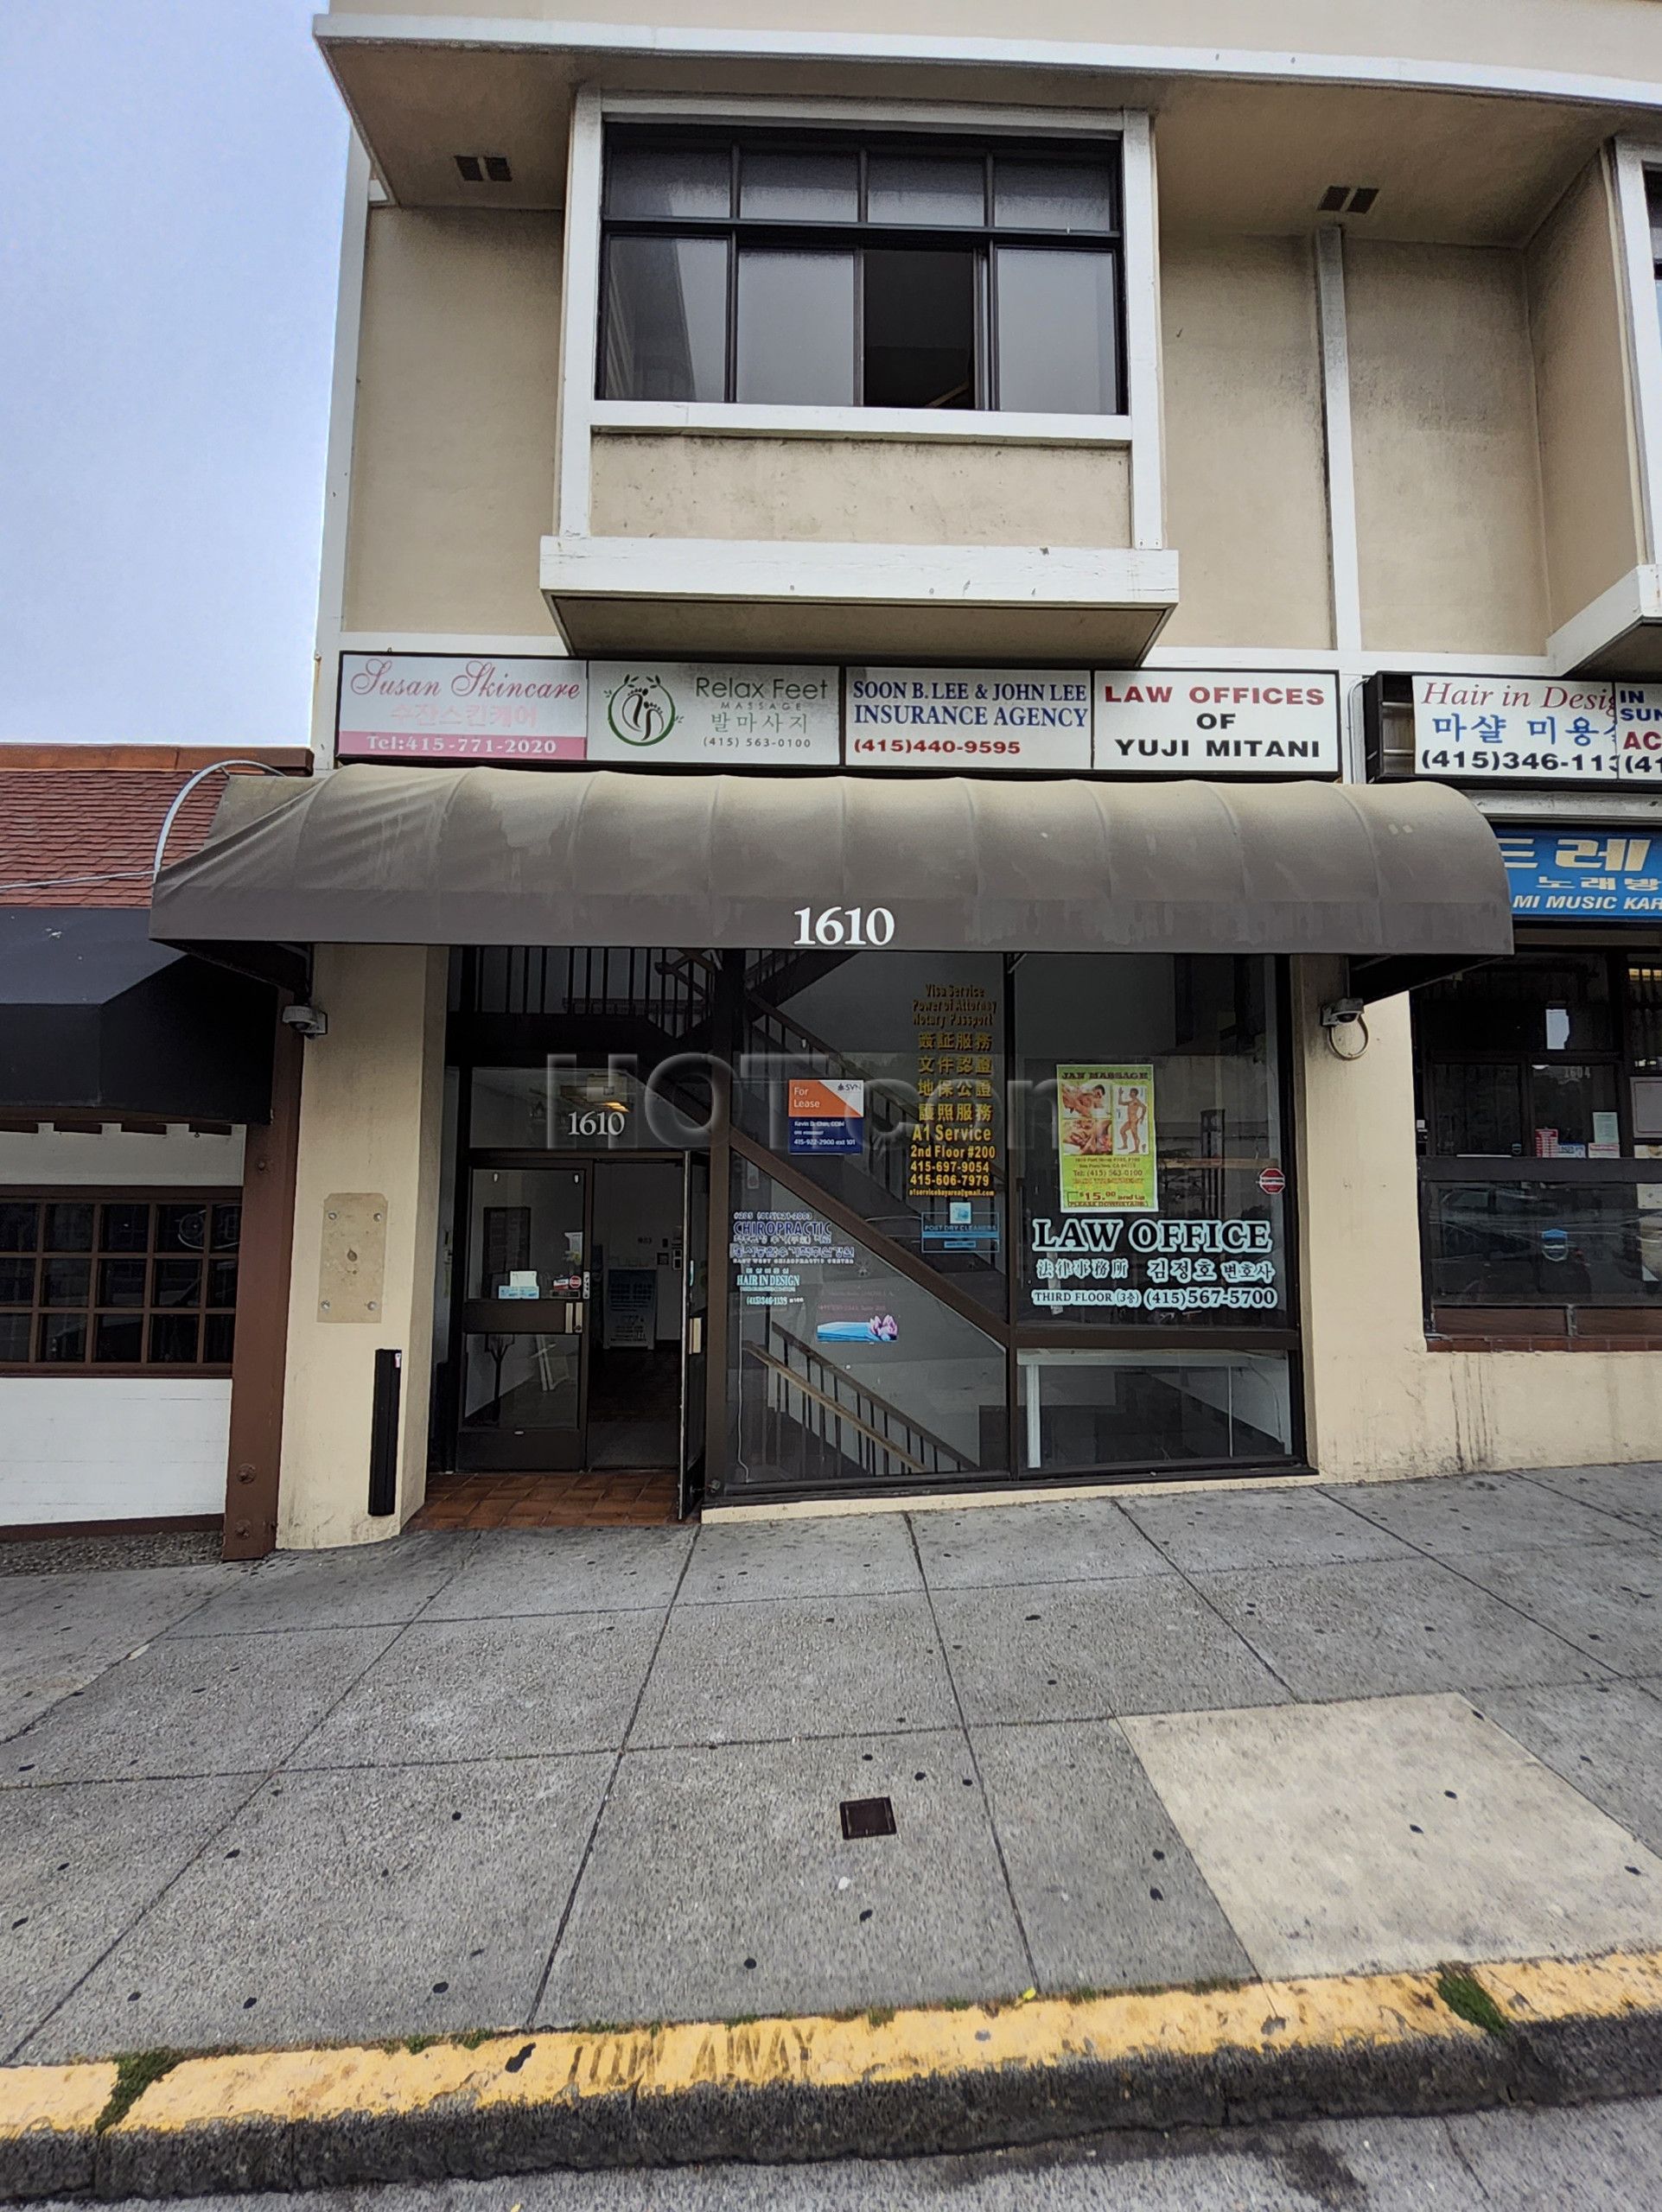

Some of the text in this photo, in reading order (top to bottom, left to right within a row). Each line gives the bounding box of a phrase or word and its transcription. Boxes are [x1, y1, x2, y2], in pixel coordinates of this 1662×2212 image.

[350, 658, 581, 700] Susan Skincare
[695, 677, 829, 700] Relax Feet
[853, 681, 1087, 702] SOON B. LEE & JOHN LEE
[1105, 685, 1325, 706] LAW OFFICES
[1421, 682, 1493, 706] Hair
[1502, 684, 1531, 708] in
[1620, 690, 1645, 704] IN
[720, 702, 802, 711] MASSAGE
[854, 704, 1088, 728] INSURANCE AGENCY
[1195, 713, 1237, 730] OF
[366, 734, 557, 754] Tel:415-771-2020
[703, 737, 812, 748] (415) 563-0100
[854, 739, 1022, 754] (415)440-9595
[1114, 739, 1320, 758] YUJI MITANI
[1535, 876, 1662, 892] 노래방
[1512, 894, 1541, 908] MI
[1545, 895, 1619, 910] MUSIC
[793, 906, 895, 946] 1610
[1089, 1071, 1149, 1080] MASSAGE
[793, 1087, 809, 1096] For
[793, 1099, 820, 1108] Lease
[568, 1110, 625, 1136] 1610
[912, 1123, 992, 1141] A1 Service
[910, 1145, 996, 1159] 2nd Floor #200
[910, 1160, 990, 1173] 415-697-9054
[910, 1174, 990, 1186] 415-606-7979
[733, 1221, 832, 1236] CHIROPRACTIC
[1032, 1218, 1273, 1253] LAW OFFICE
[1147, 1258, 1277, 1284] 김정호 변호사
[736, 1274, 800, 1287] HAIR IN DESIGN
[1032, 1289, 1073, 1306] THIRD
[1073, 1289, 1113, 1306] FLOOR
[1143, 1287, 1279, 1310] (415)567-5700
[690, 2024, 817, 2082] AWAY
